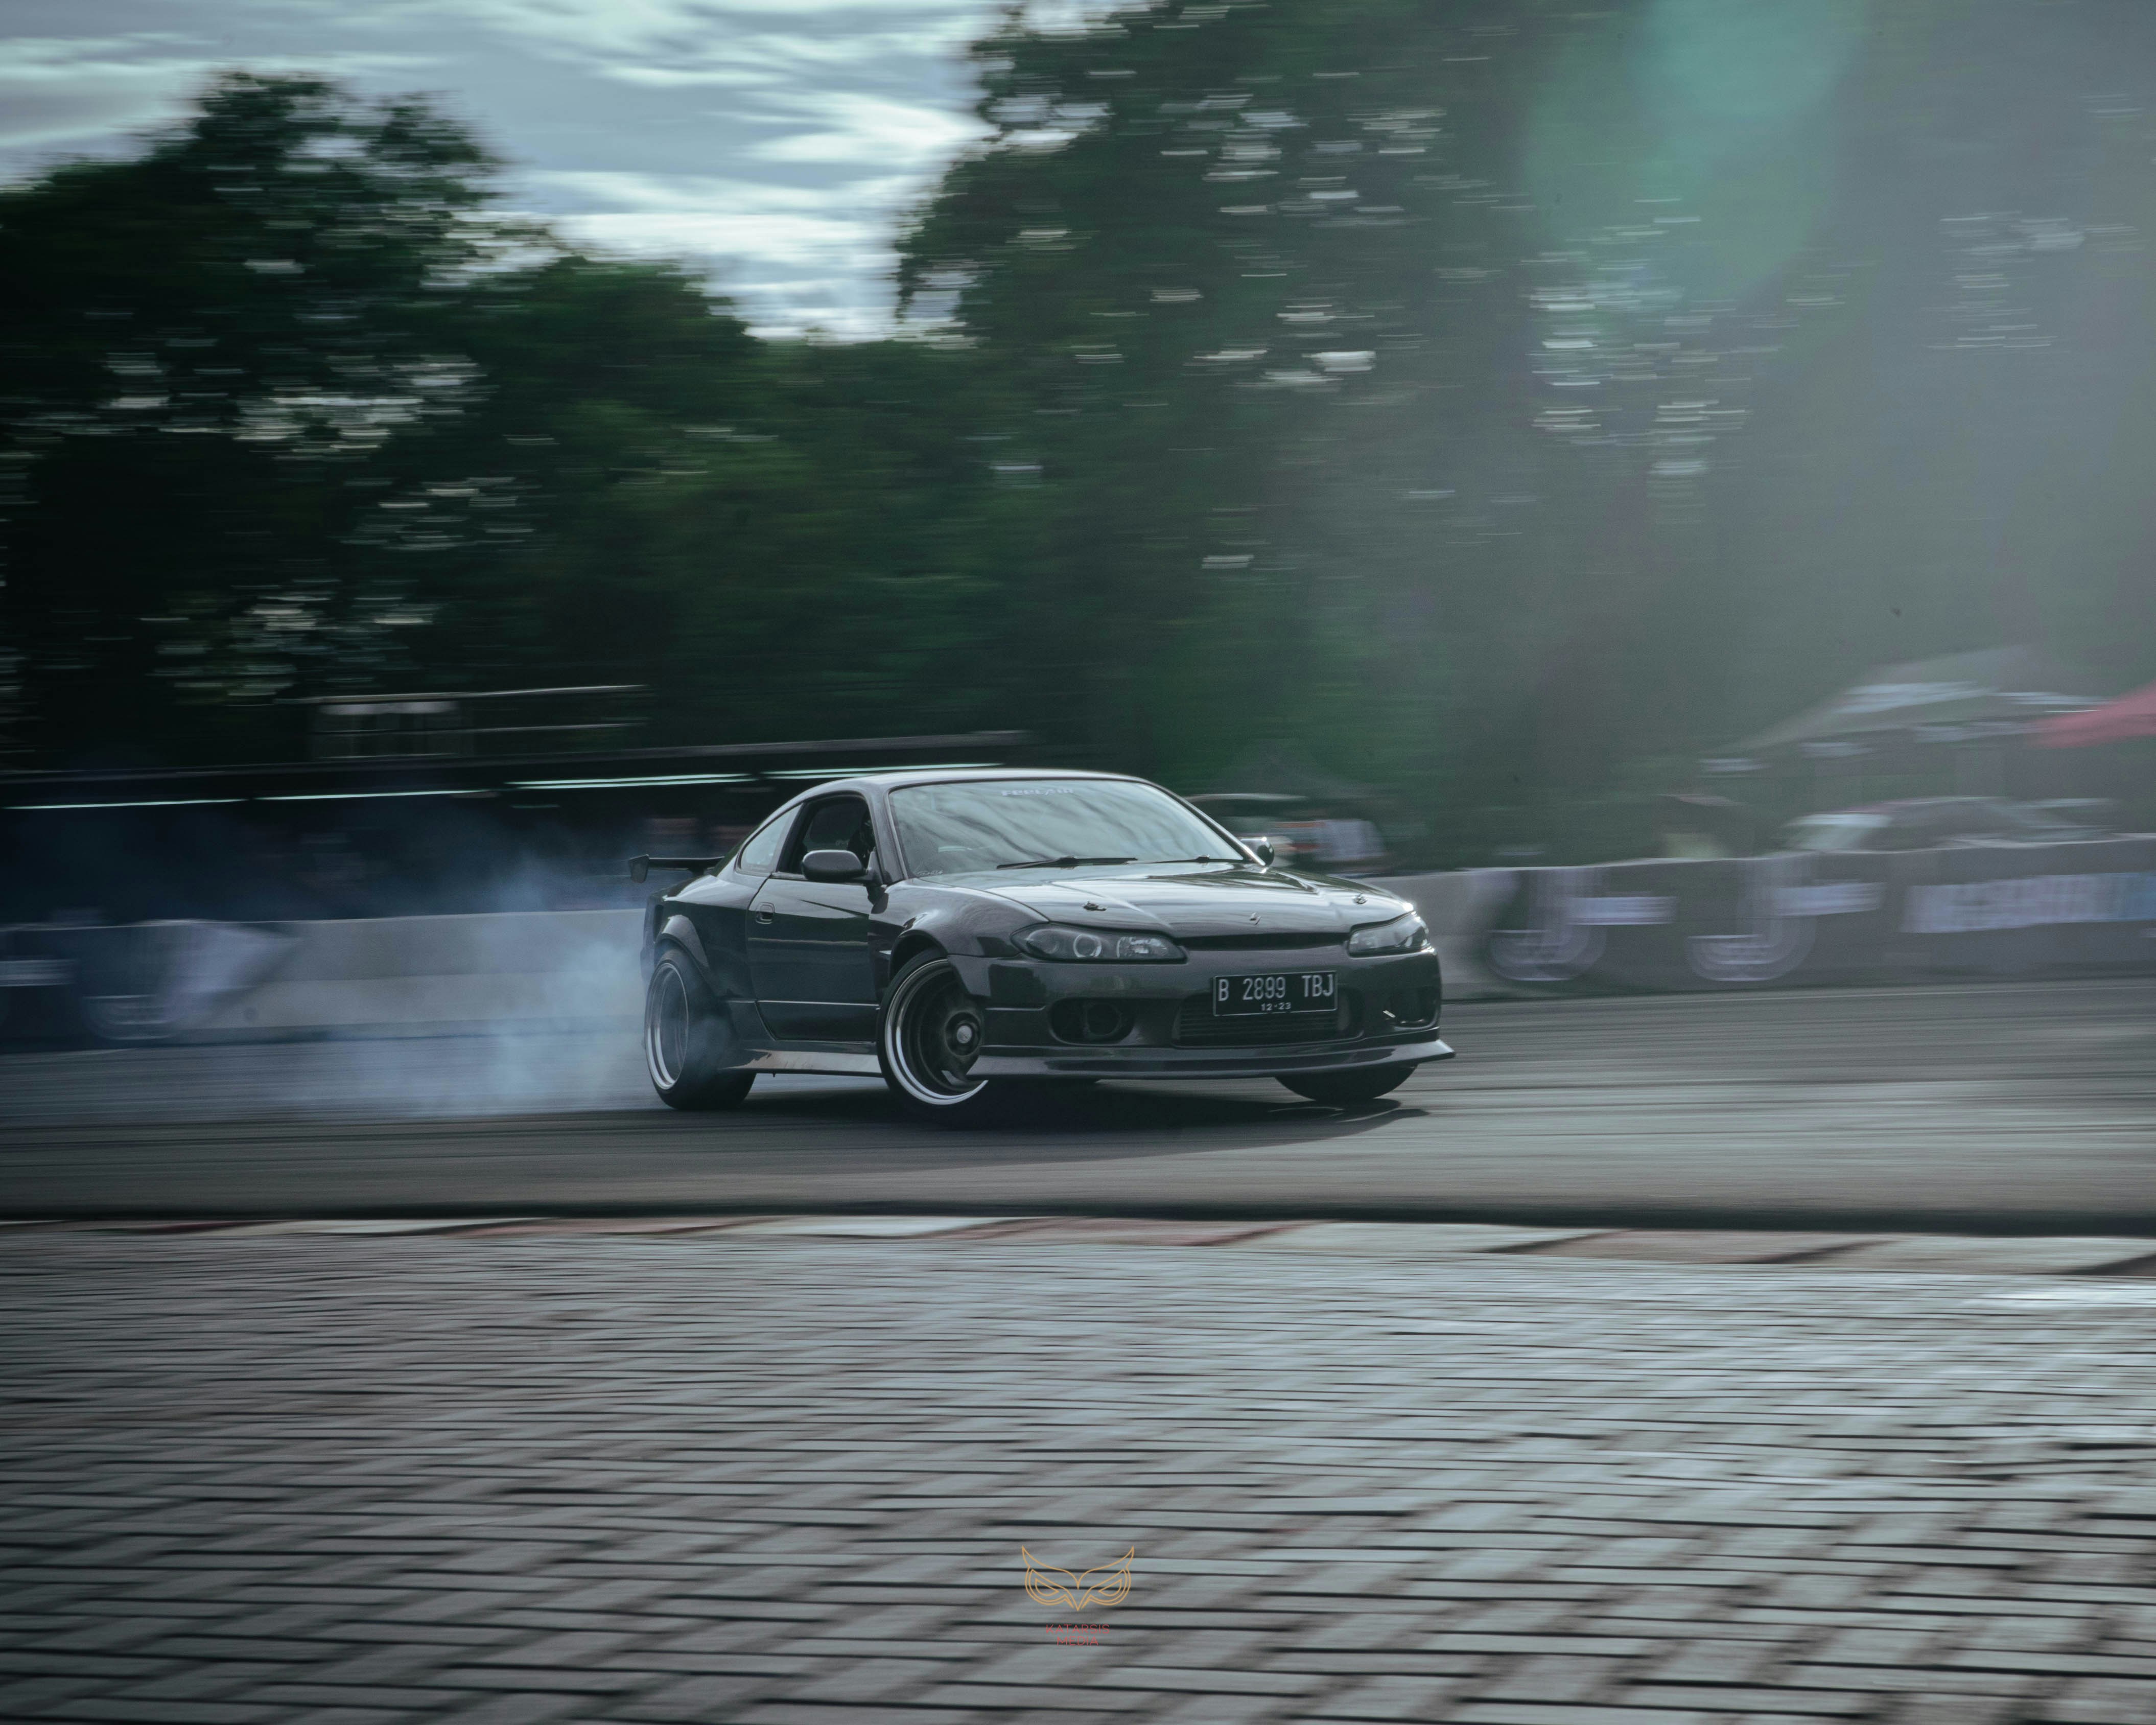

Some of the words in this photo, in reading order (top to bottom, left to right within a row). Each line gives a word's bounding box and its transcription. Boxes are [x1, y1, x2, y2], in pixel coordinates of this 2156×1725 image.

[1218, 979, 1229, 1001] B
[1242, 976, 1286, 1000] 2899
[1301, 974, 1334, 997] TBJ
